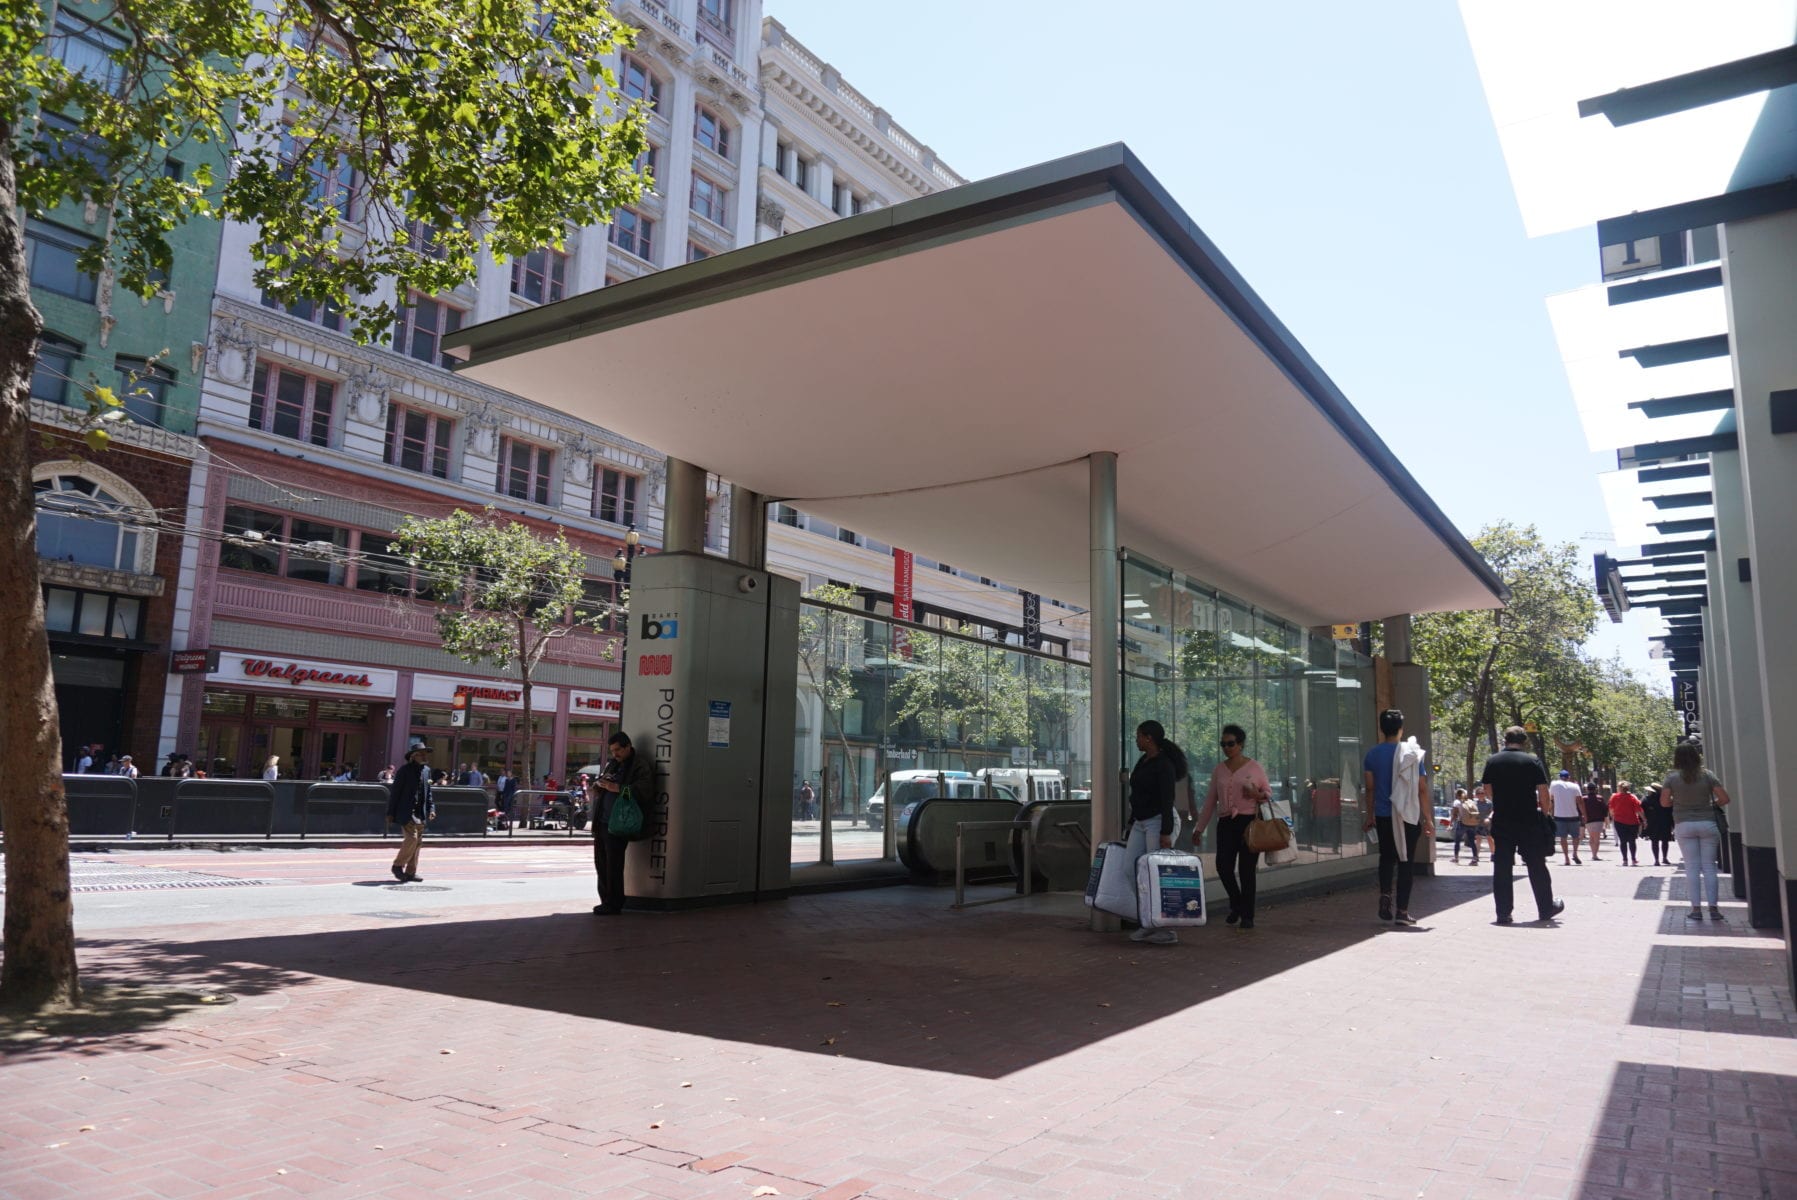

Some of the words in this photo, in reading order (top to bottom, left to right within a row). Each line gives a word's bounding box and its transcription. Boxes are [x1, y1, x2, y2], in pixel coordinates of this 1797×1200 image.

[174, 653, 206, 664] Walgreens
[241, 658, 373, 688] Walgreens
[456, 684, 522, 702] PHARMACY
[1683, 681, 1696, 723] ALDO
[655, 688, 674, 777] POWELL
[649, 791, 670, 885] STREET
